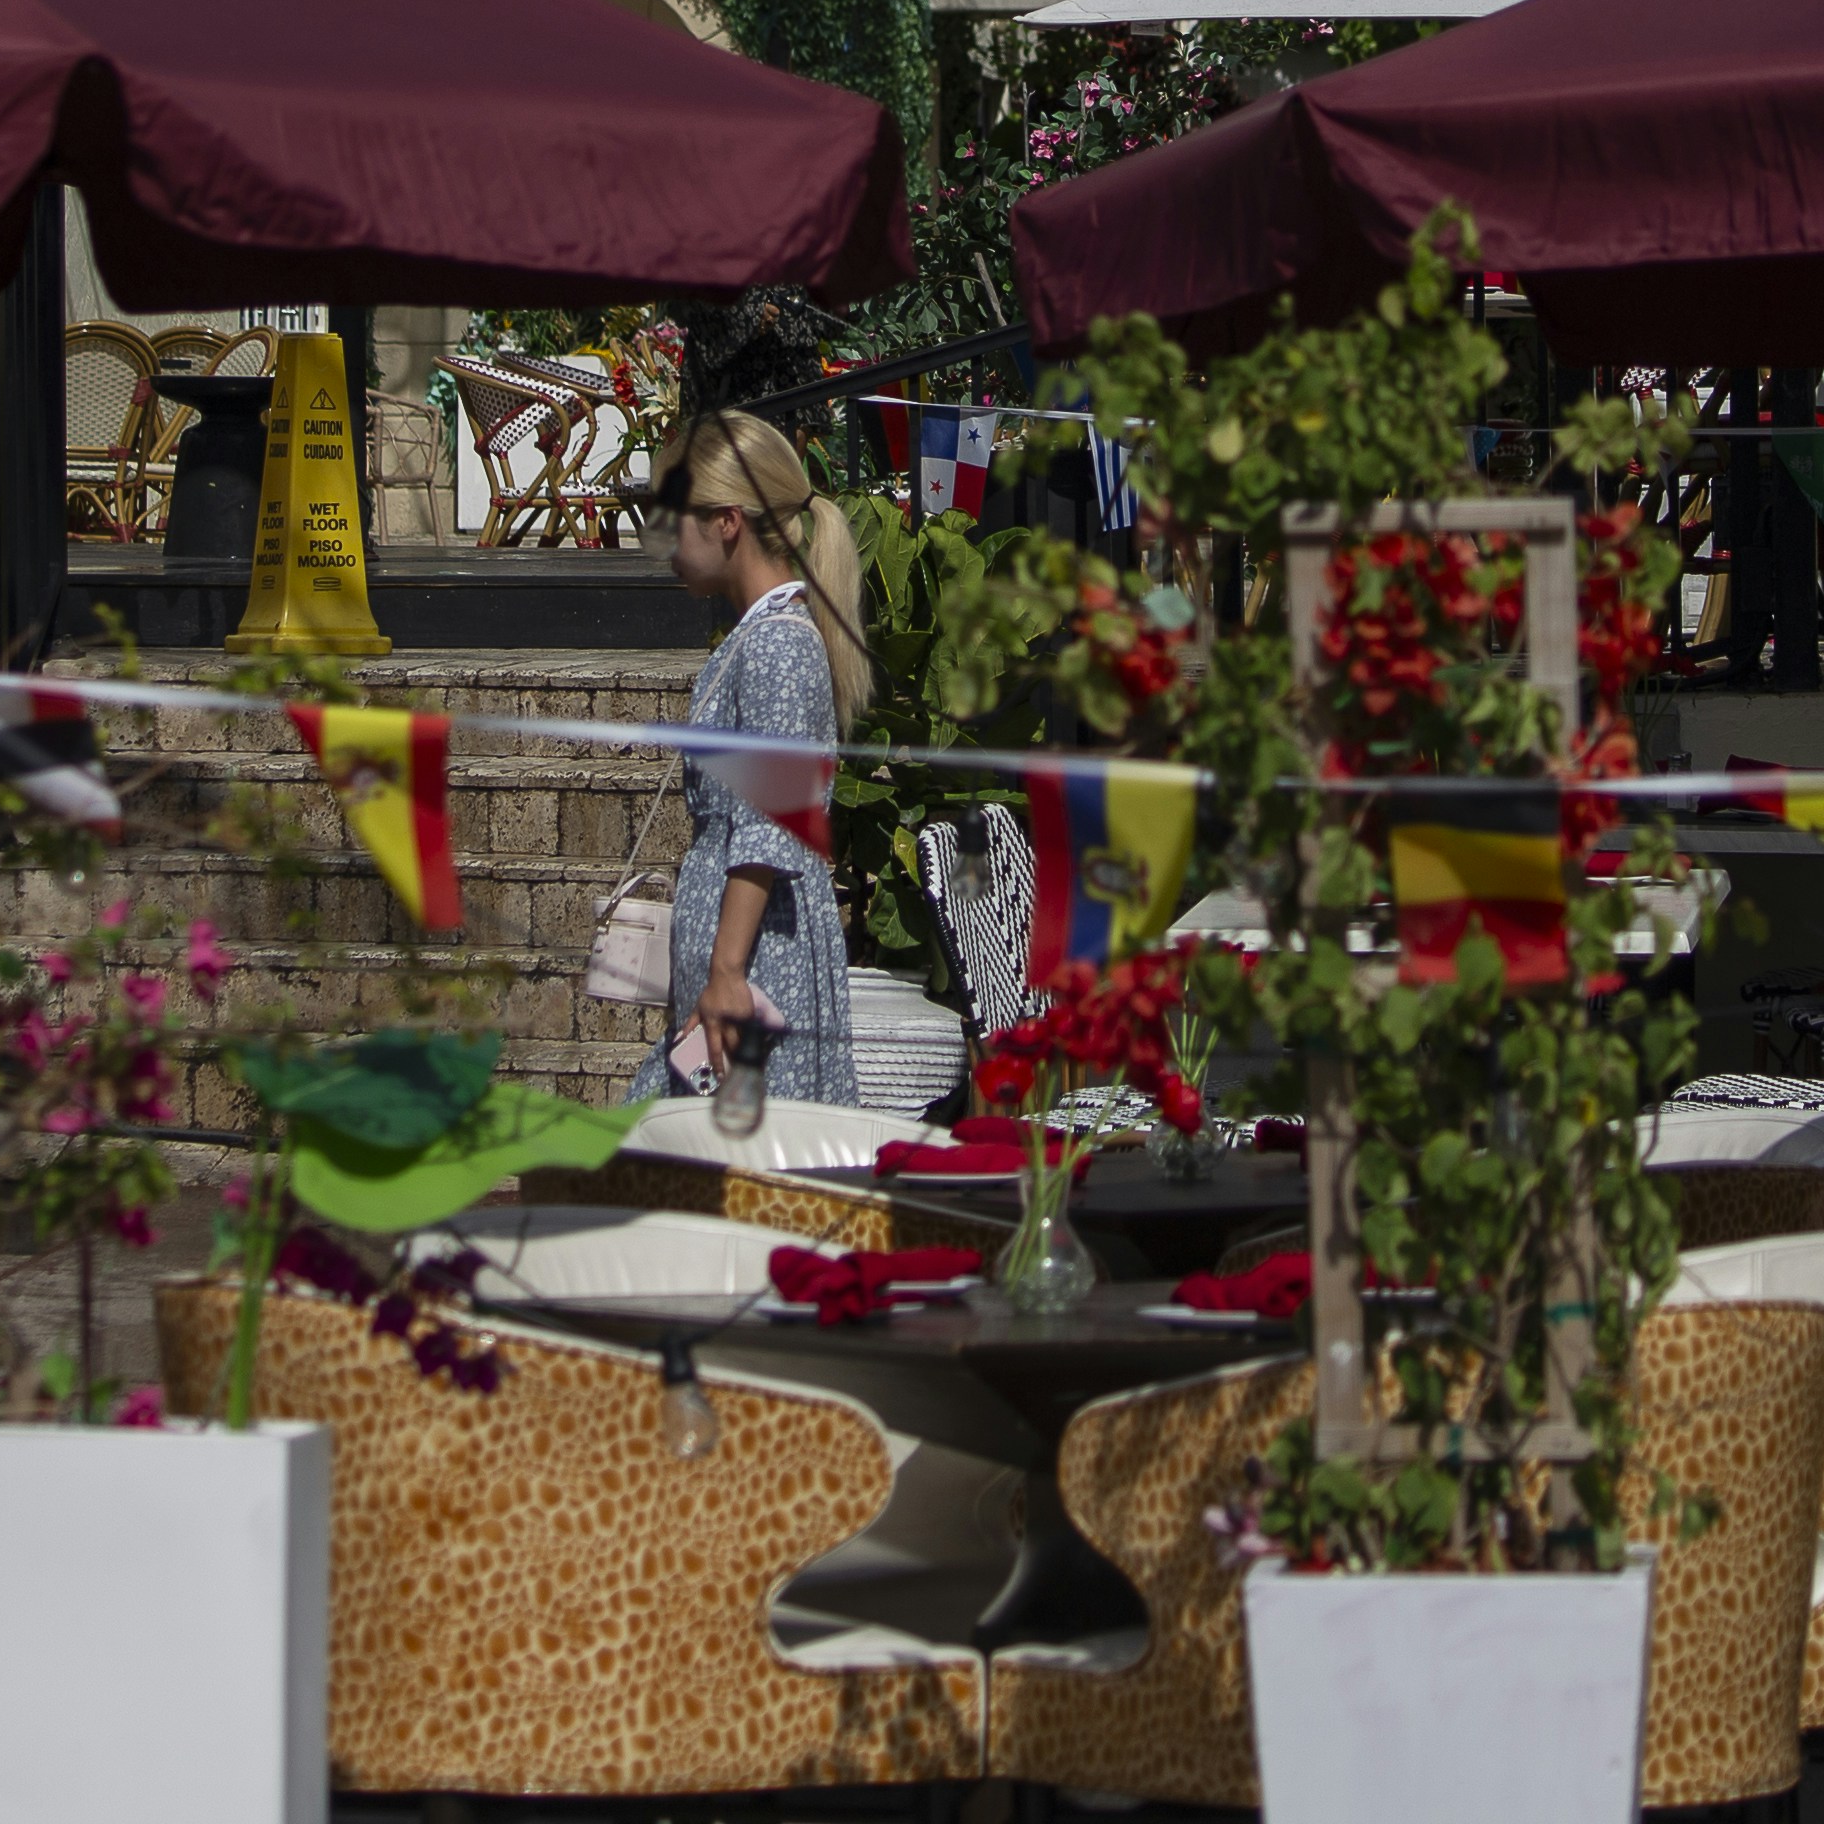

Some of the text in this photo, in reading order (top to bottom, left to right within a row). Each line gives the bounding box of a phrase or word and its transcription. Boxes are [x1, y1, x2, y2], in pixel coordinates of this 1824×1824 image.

[303, 419, 343, 436] CAUTION
[303, 443, 344, 460] CUIDADO
[308, 502, 340, 515] WET
[303, 518, 348, 531] FLOOR
[310, 539, 343, 553] PISO
[297, 554, 357, 568] MOJADO
